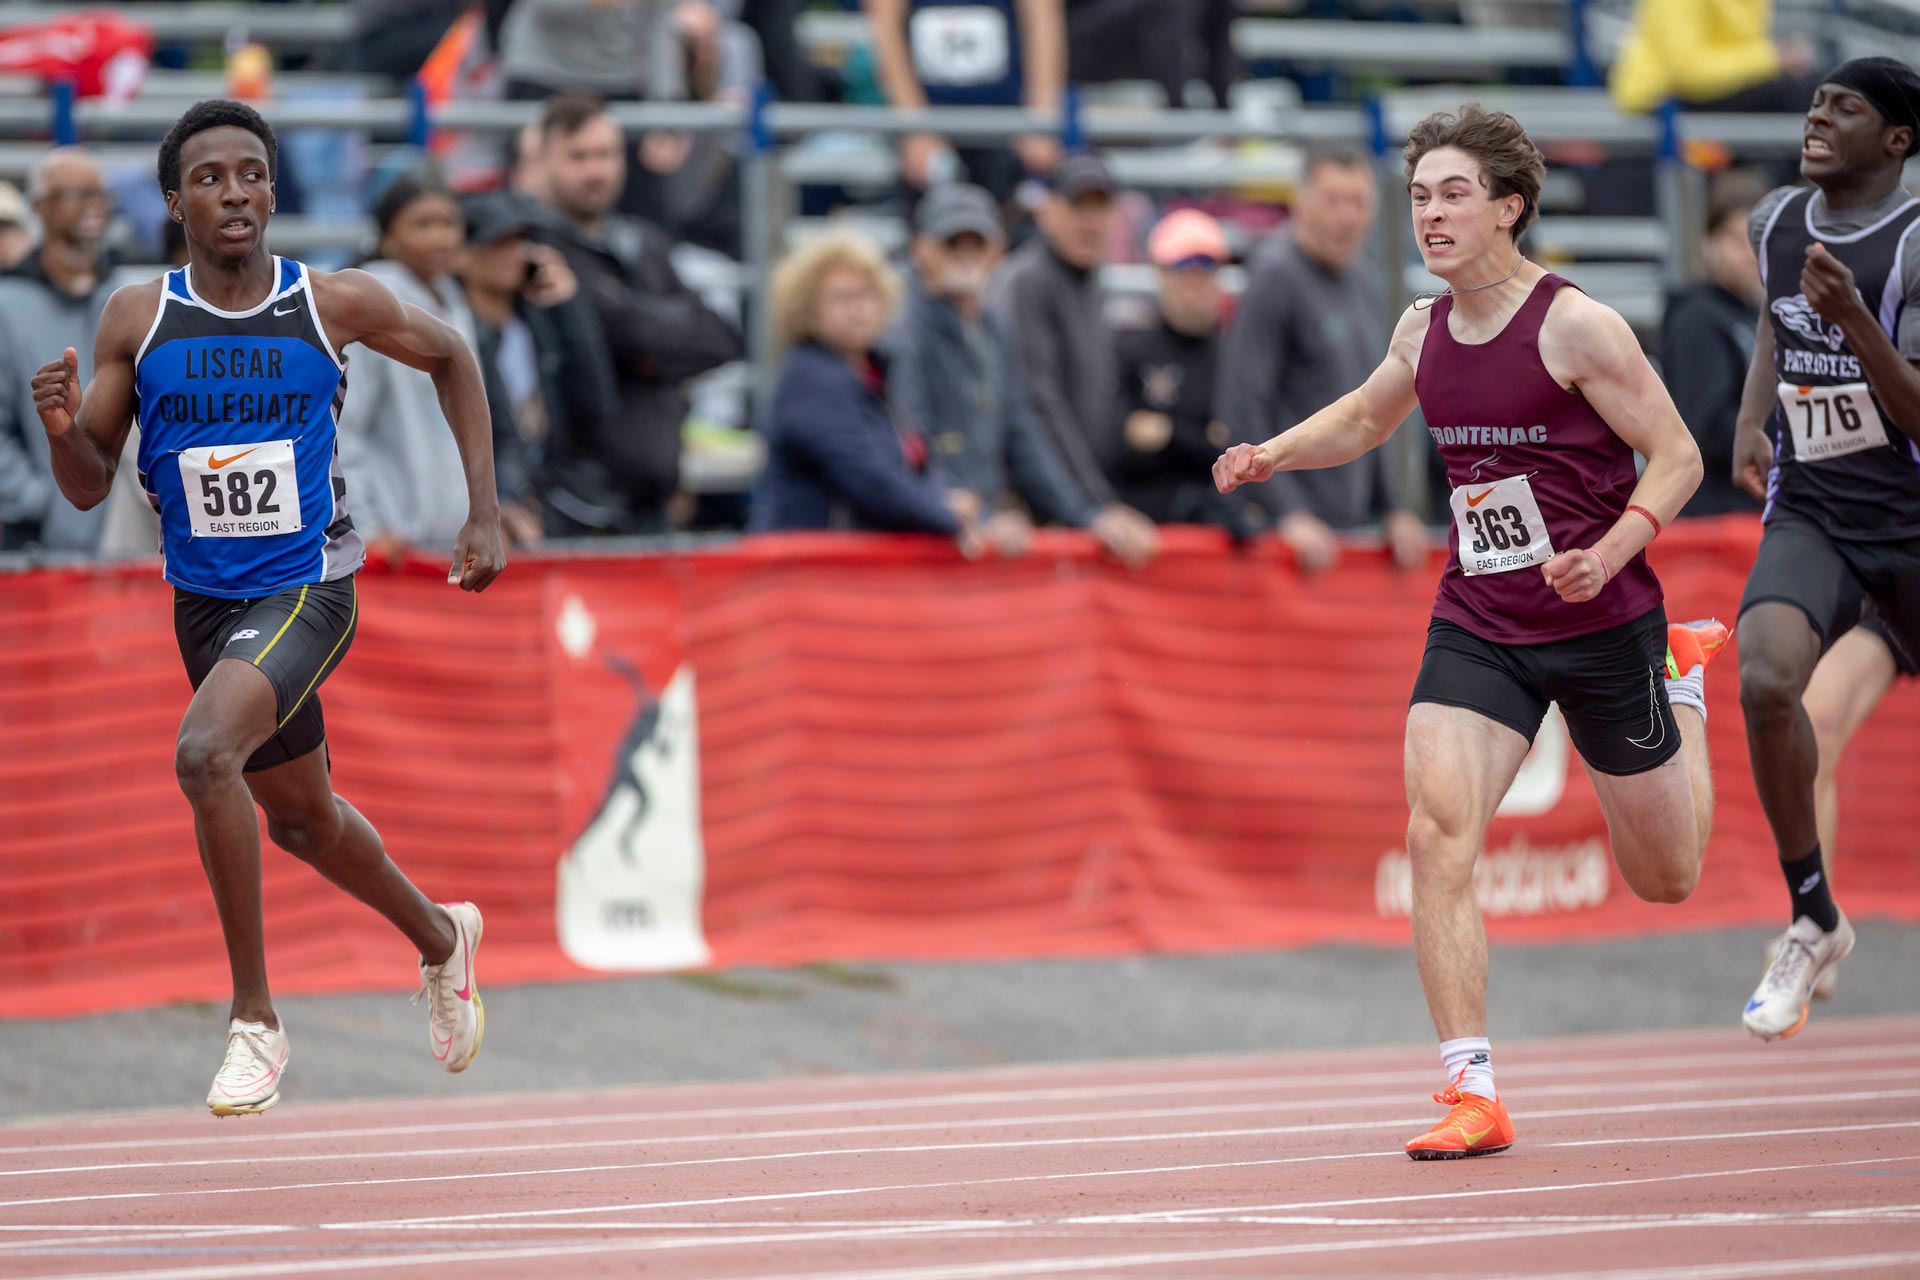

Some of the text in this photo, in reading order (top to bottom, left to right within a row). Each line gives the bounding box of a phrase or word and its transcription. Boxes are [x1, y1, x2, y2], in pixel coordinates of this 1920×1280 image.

[186, 347, 283, 379] LISGAR
[1783, 348, 1862, 379] PATRIOTES
[159, 393, 312, 424] COLLEGIATE
[1795, 393, 1862, 439] 776
[1428, 425, 1548, 446] FRONTENAC
[1808, 437, 1867, 455] EAST REGION
[200, 469, 280, 517] 582
[210, 520, 280, 533] EAST REGION
[1466, 505, 1531, 553] 363
[1476, 552, 1534, 571] EAST REGION
